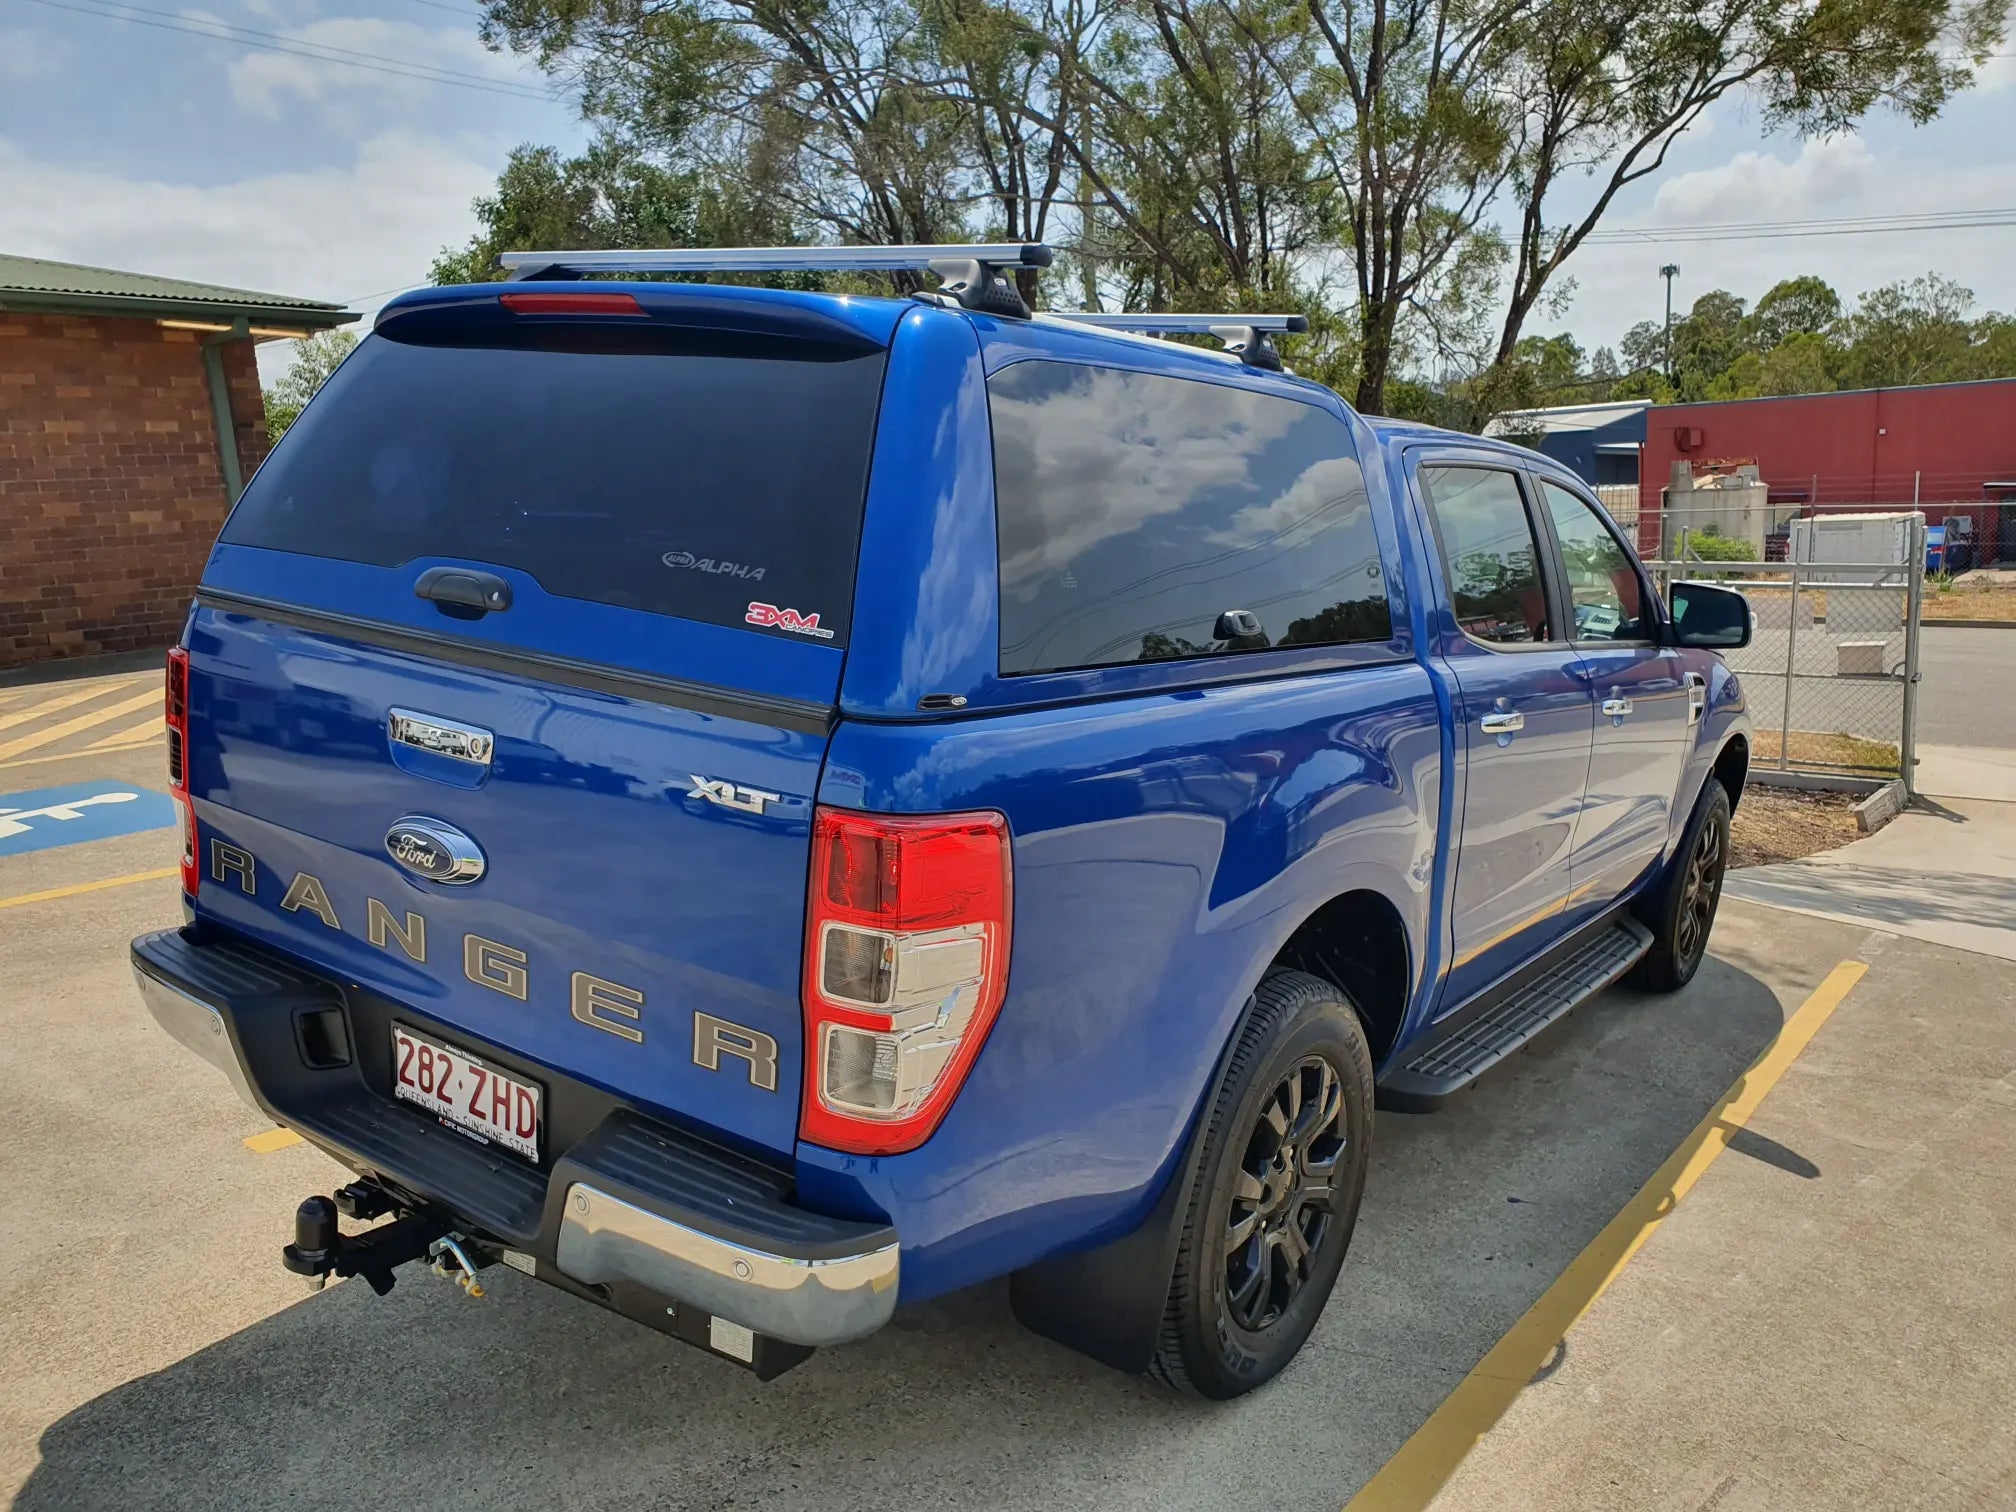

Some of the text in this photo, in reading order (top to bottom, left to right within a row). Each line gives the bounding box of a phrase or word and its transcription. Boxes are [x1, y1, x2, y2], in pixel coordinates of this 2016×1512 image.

[690, 558, 767, 581] ALPHA
[745, 602, 821, 629] 3XM
[785, 623, 834, 638] CANOPIES
[687, 773, 780, 814] XLT
[396, 835, 437, 869] Ford
[210, 836, 779, 1093] RANGER
[400, 1086, 454, 1120] QUEENSLAND
[463, 1115, 504, 1142] SUNSHINE
[508, 1137, 537, 1160] STATE
